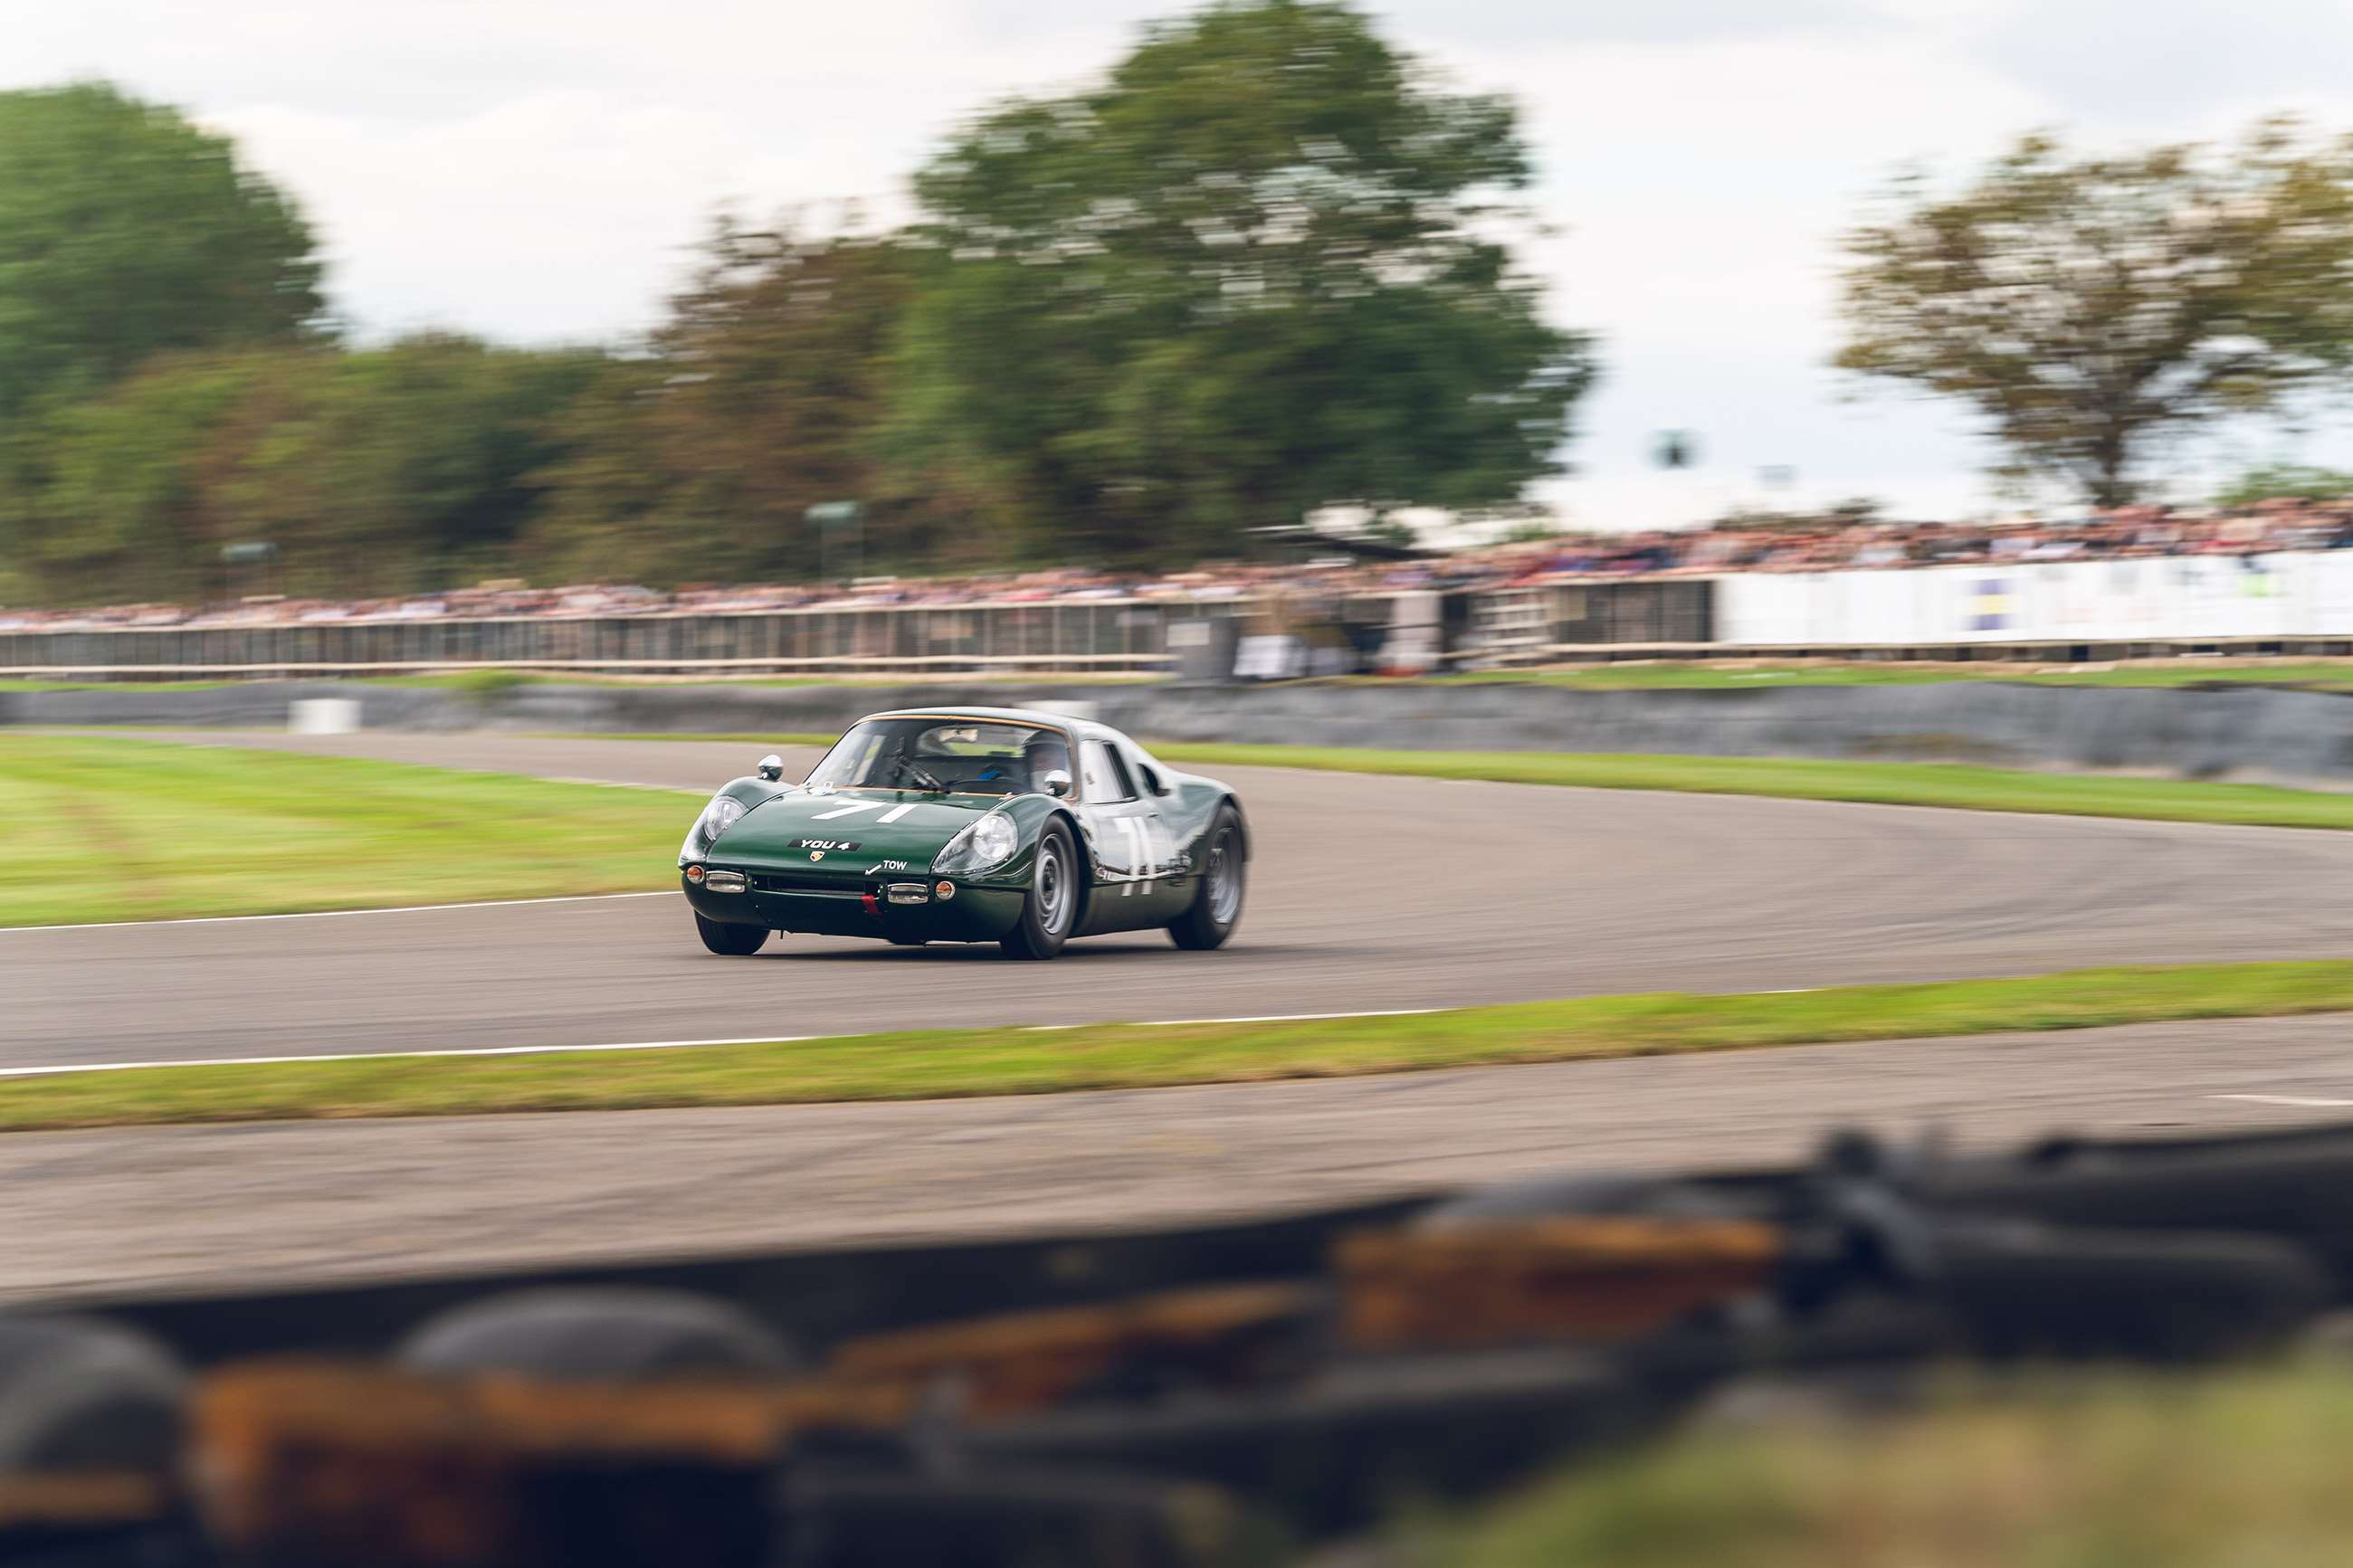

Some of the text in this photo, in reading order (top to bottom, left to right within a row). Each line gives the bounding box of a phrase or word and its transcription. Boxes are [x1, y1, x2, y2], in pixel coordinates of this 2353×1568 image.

[811, 800, 919, 823] 71
[800, 840, 851, 851] YOU 4
[882, 860, 908, 870] TOW
[1114, 817, 1157, 897] 71
